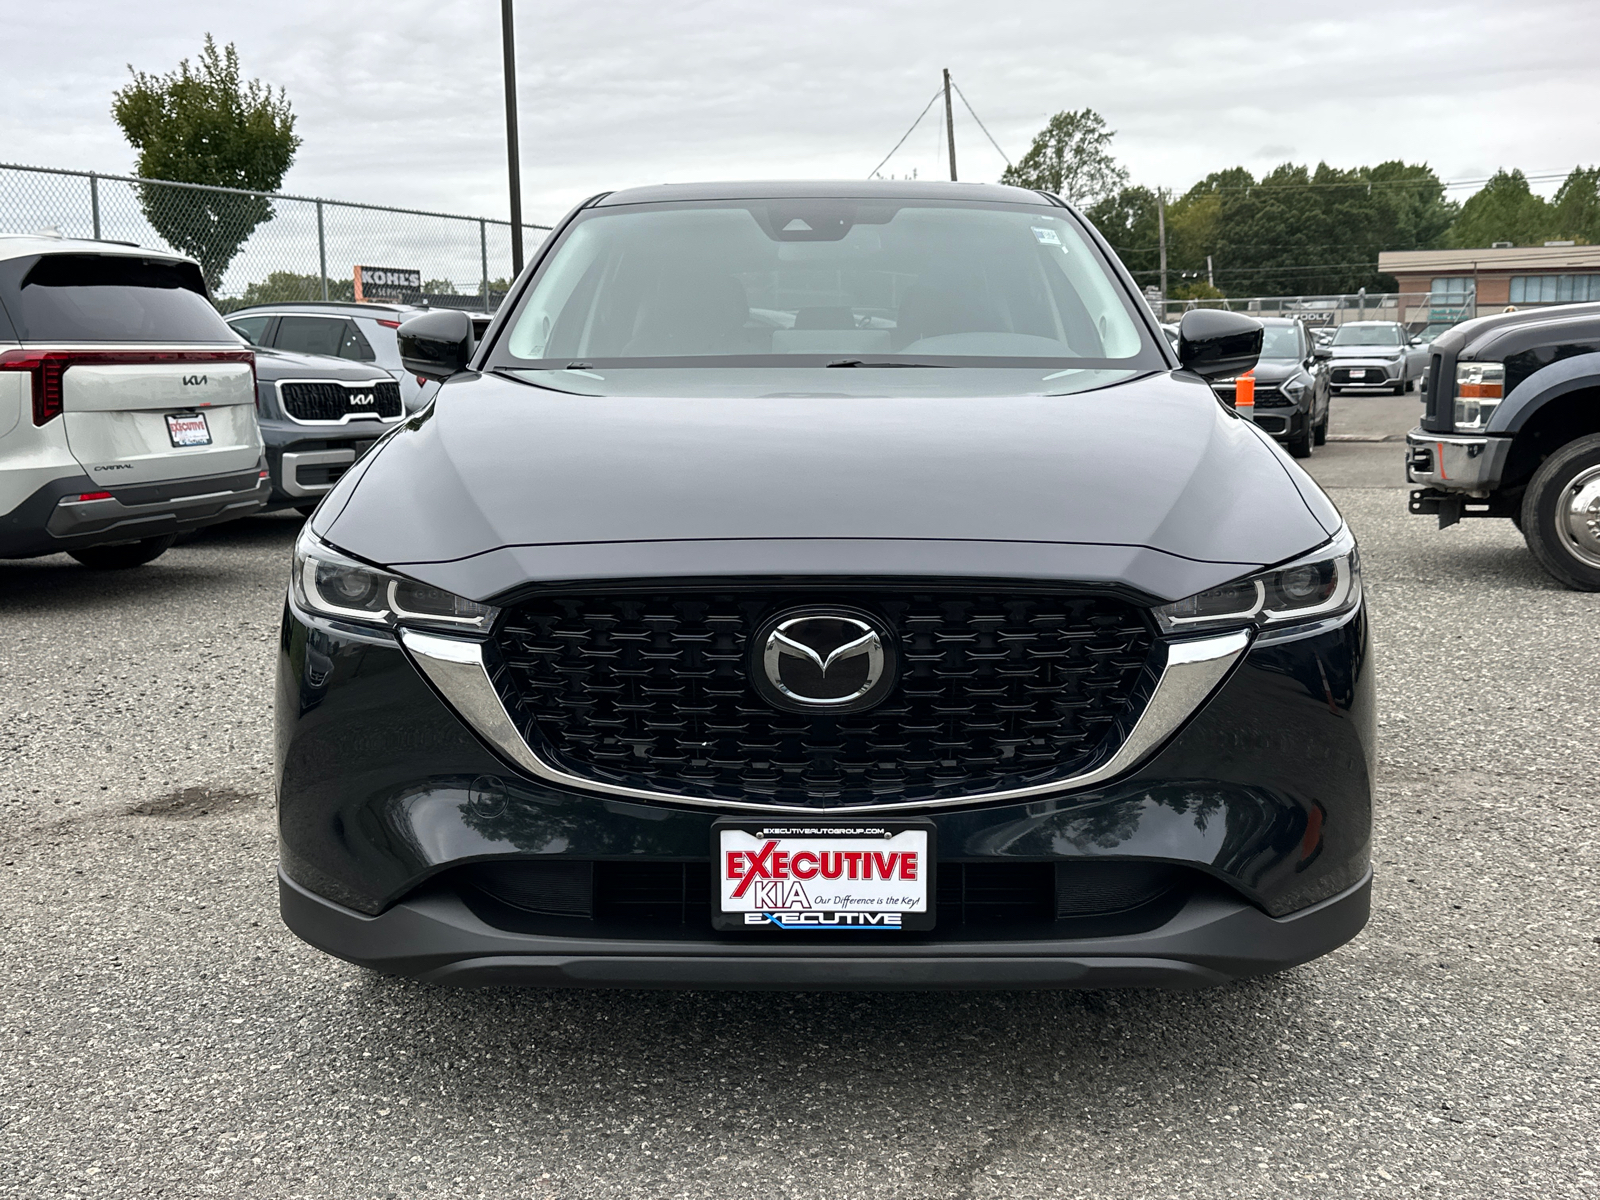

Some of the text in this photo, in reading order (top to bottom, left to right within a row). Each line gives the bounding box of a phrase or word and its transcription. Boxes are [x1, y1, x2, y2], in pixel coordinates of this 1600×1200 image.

[361, 270, 420, 287] KOHL'S
[763, 827, 885, 835] EXECUTIVEAUTOGROUP.COM
[726, 840, 918, 899] EXECUTIVE
[754, 881, 812, 909] KIA
[814, 894, 921, 910] Our Difference is the Key!
[744, 912, 902, 927] EXECUTIVE
